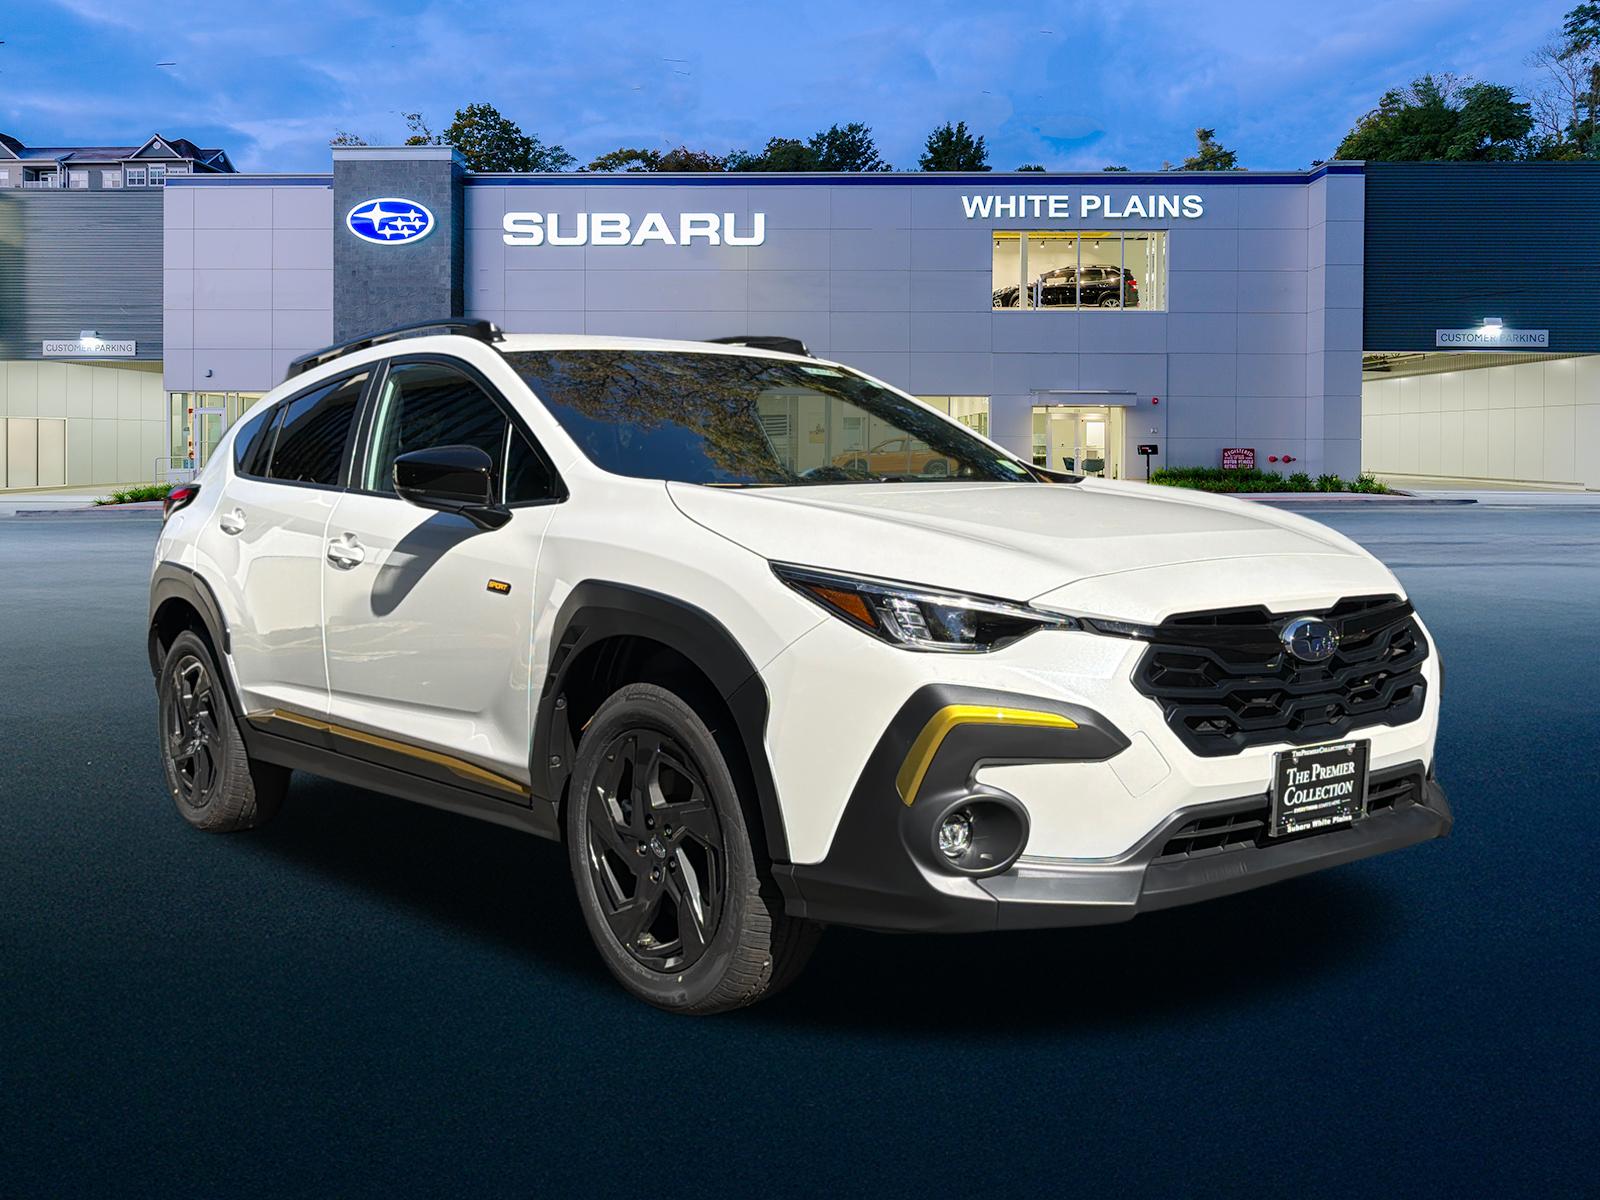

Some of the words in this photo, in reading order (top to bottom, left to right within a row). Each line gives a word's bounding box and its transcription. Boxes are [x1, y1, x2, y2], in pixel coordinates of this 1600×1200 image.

[961, 195, 1069, 218] WHITE
[1081, 195, 1204, 218] PLAINS
[502, 212, 765, 246] SUBARU
[95, 343, 133, 352] PARKING
[1440, 333, 1496, 343] CUSTOMER
[1501, 333, 1545, 343] PARKING
[488, 581, 508, 591] SPORT
[1286, 767, 1310, 786] THE
[1311, 761, 1355, 782] PREMIER
[1283, 780, 1354, 806] COLLECTION
[1287, 823, 1311, 833] Subaru
[1312, 818, 1331, 828] White
